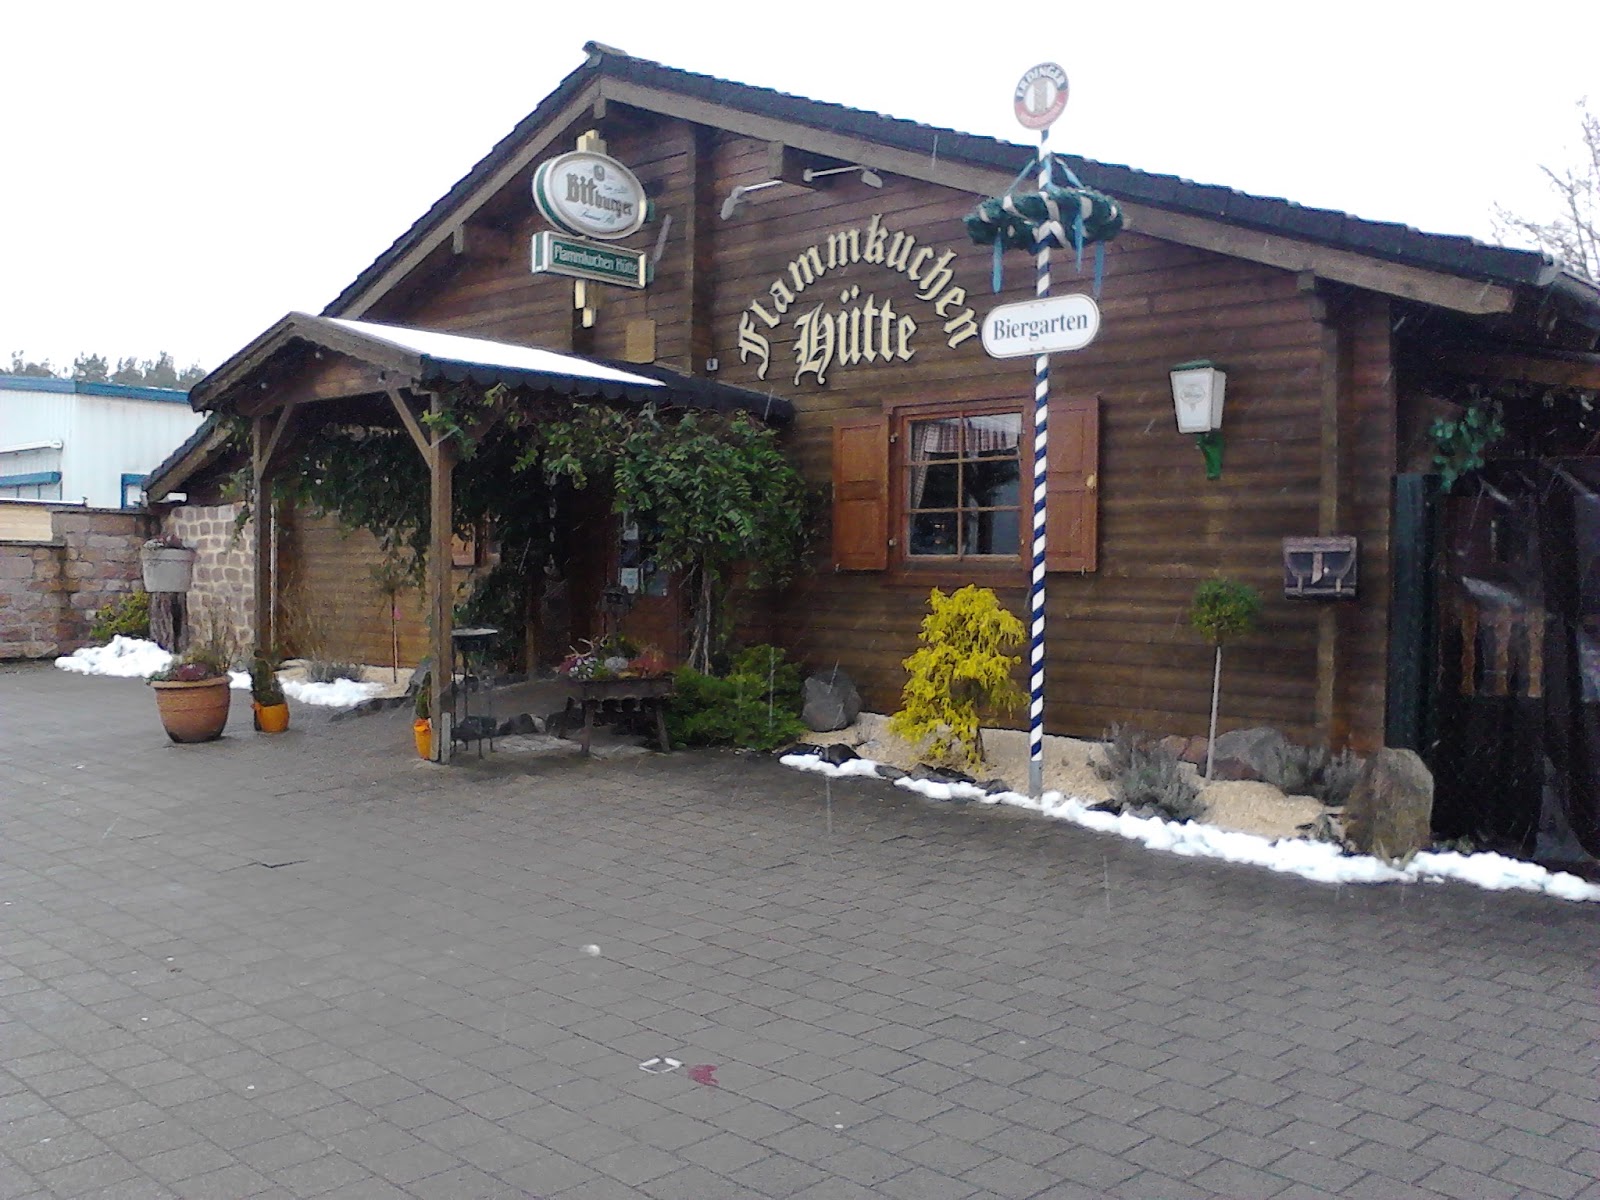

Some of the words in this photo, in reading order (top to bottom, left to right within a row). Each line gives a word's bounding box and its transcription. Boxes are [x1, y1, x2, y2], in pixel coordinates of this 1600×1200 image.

[565, 173, 634, 218] Bitburger
[738, 213, 978, 380] Flammkuchen
[993, 311, 1089, 342] Biergarten
[793, 284, 918, 386] Hütte
